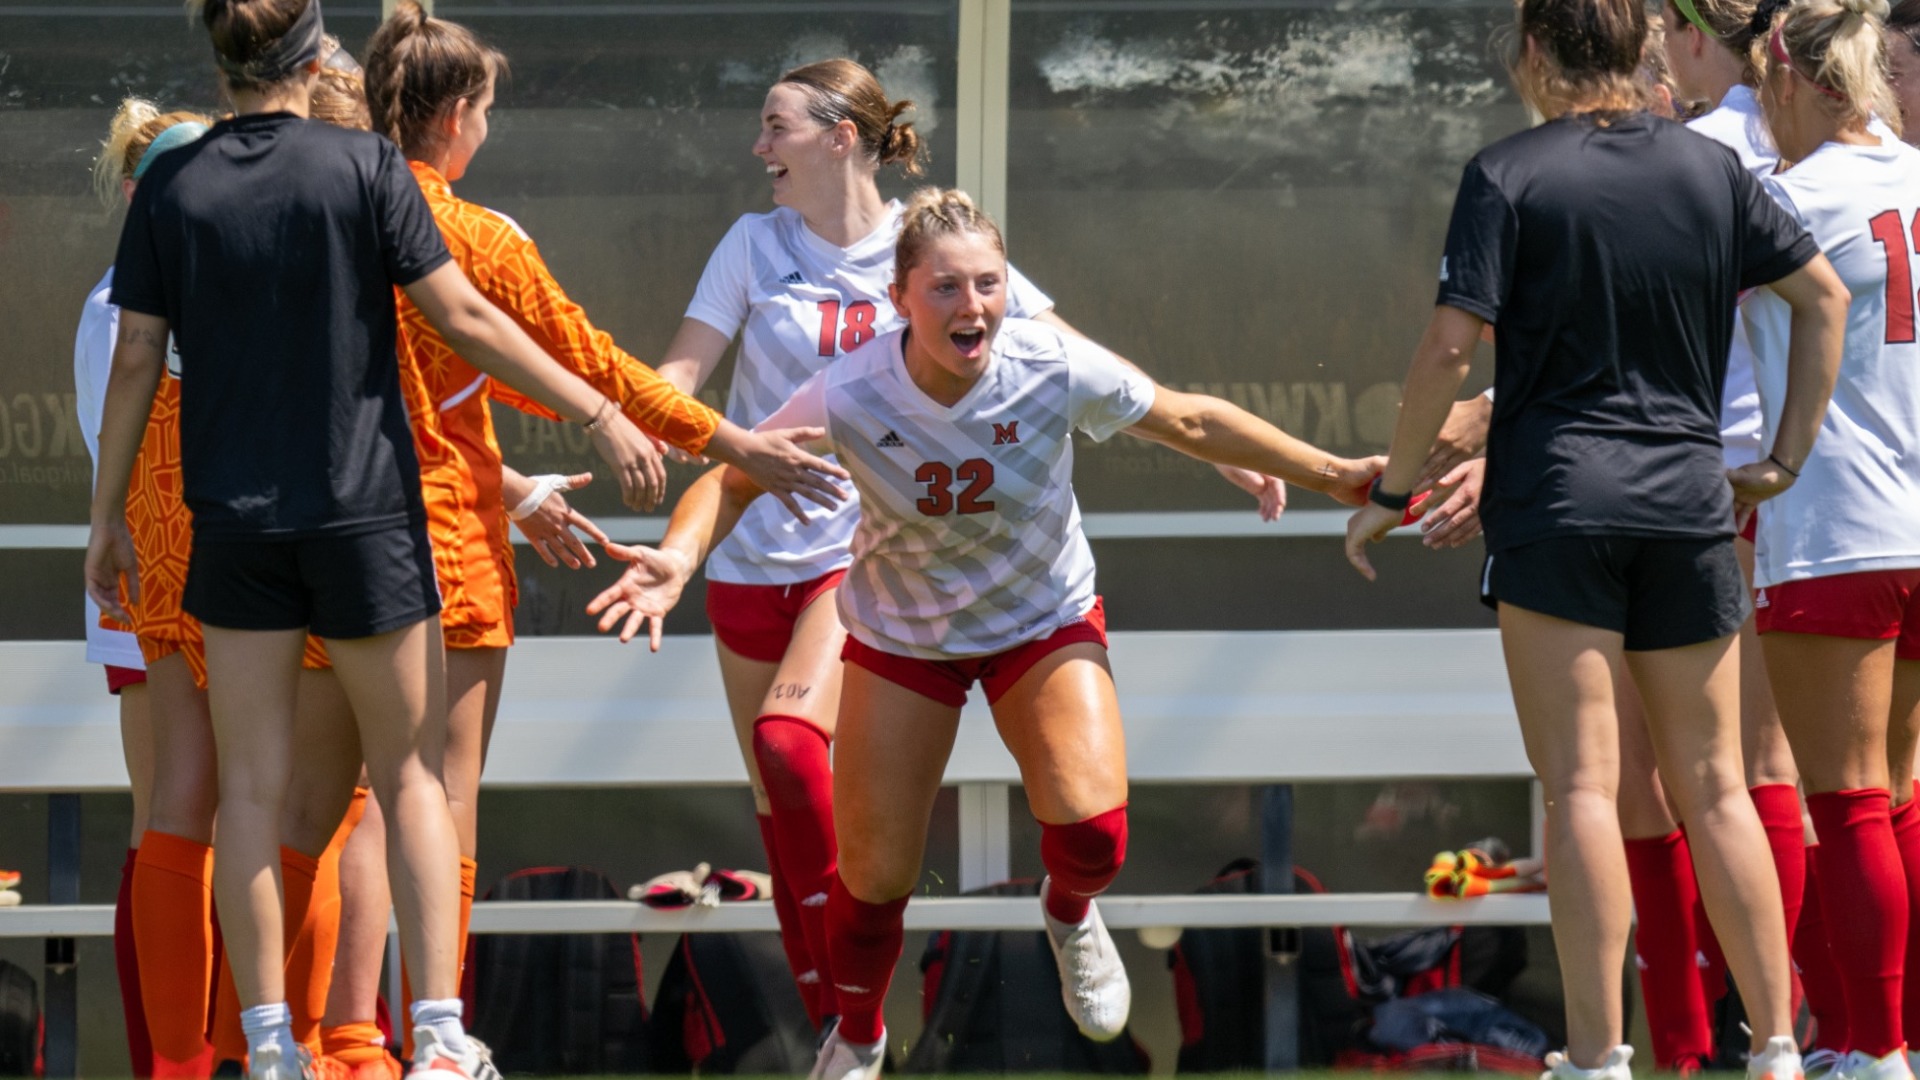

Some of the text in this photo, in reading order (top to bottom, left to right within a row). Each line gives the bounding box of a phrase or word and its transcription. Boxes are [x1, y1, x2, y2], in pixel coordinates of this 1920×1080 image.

[1868, 208, 1920, 345] 1
[817, 299, 876, 356] 18
[992, 420, 1020, 445] M
[915, 457, 995, 516] 32
